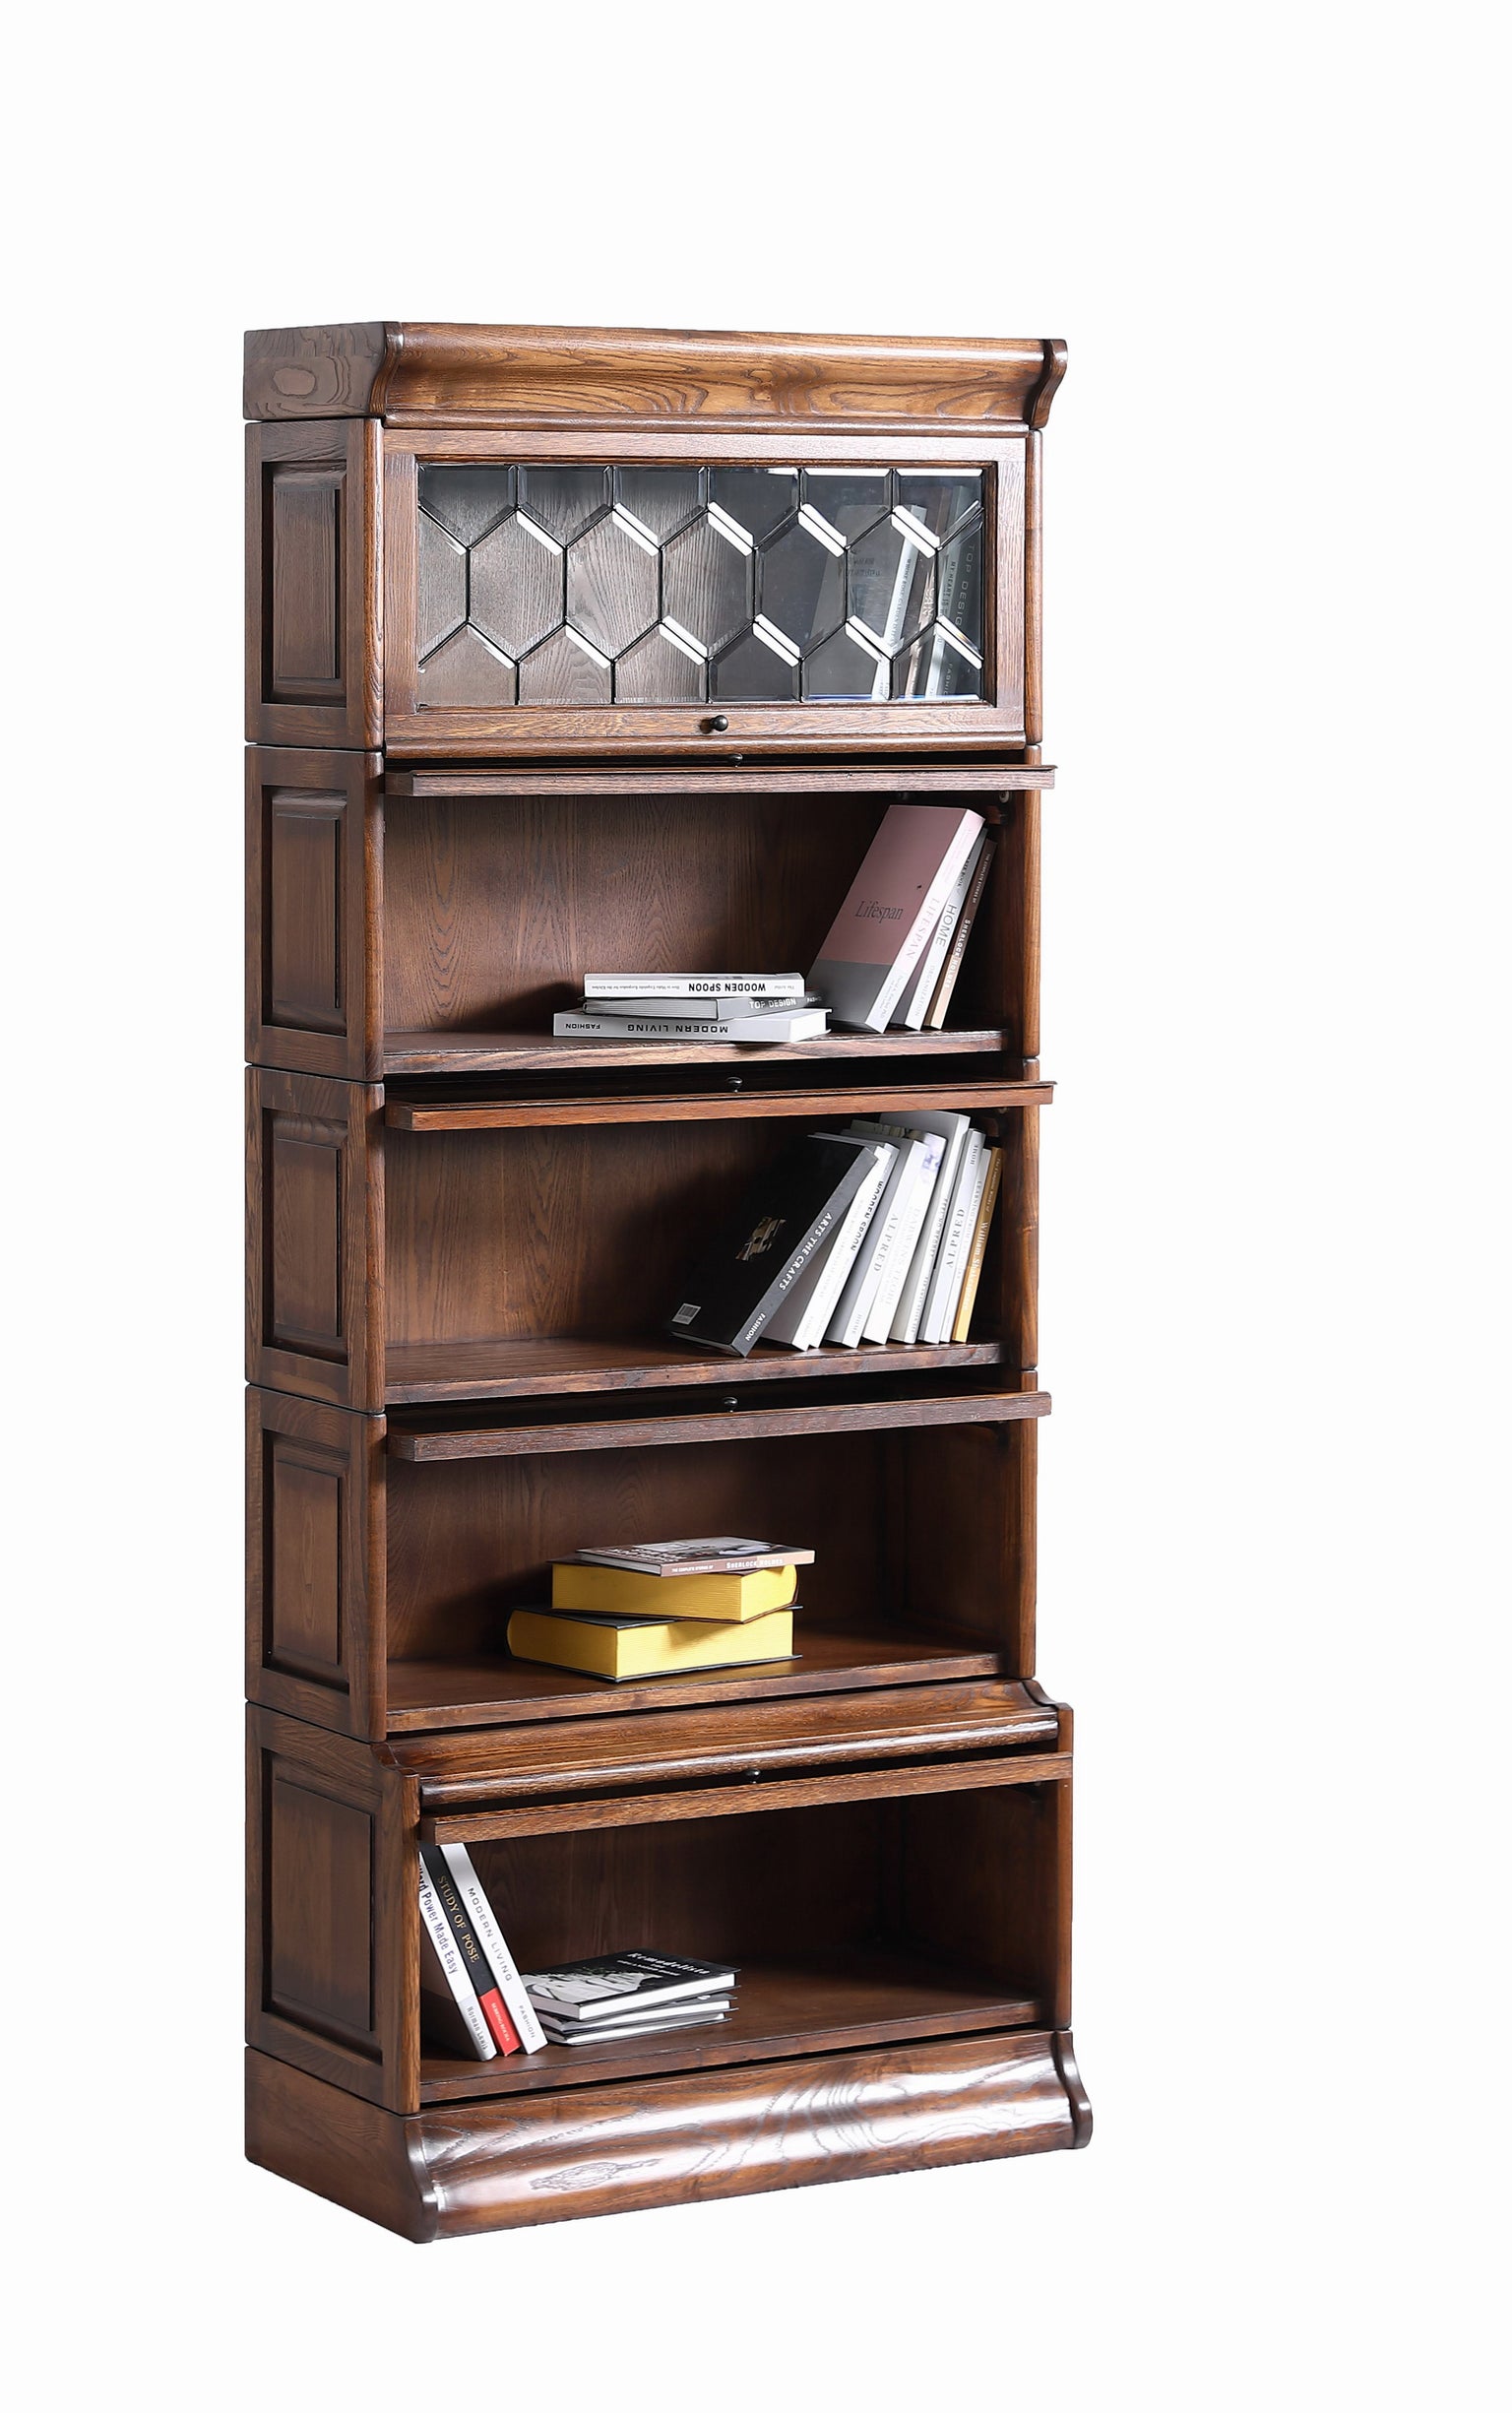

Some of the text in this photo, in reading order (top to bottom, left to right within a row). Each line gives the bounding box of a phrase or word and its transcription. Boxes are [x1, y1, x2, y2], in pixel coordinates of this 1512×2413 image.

[955, 544, 976, 626] TOP DESIG
[855, 901, 904, 922] Lifespan
[907, 898, 940, 960] LIFESPAN
[935, 904, 958, 947] HOME
[956, 919, 971, 956] SHERLOCK
[688, 983, 766, 991] WOODEN SPOON
[768, 998, 796, 1008] DESIGN
[915, 965, 935, 1016] ORGANIZATION
[864, 1180, 884, 1219] WOODEN
[779, 1213, 833, 1291] ARTS THE CRAFTS
[946, 1209, 965, 1267] ALPRED
[977, 1221, 989, 1255] William
[745, 1312, 766, 1341] FASHION
[725, 1560, 757, 1569] SHERLOCK
[421, 1887, 438, 1924] Power
[433, 1924, 448, 1950] Made
[445, 1948, 459, 1975] Easy
[437, 1875, 480, 1963] STUDY OF POSE
[467, 1887, 493, 1937] MODERN
[491, 1942, 512, 1982] LIVING
[519, 2005, 536, 2038] FASHION
